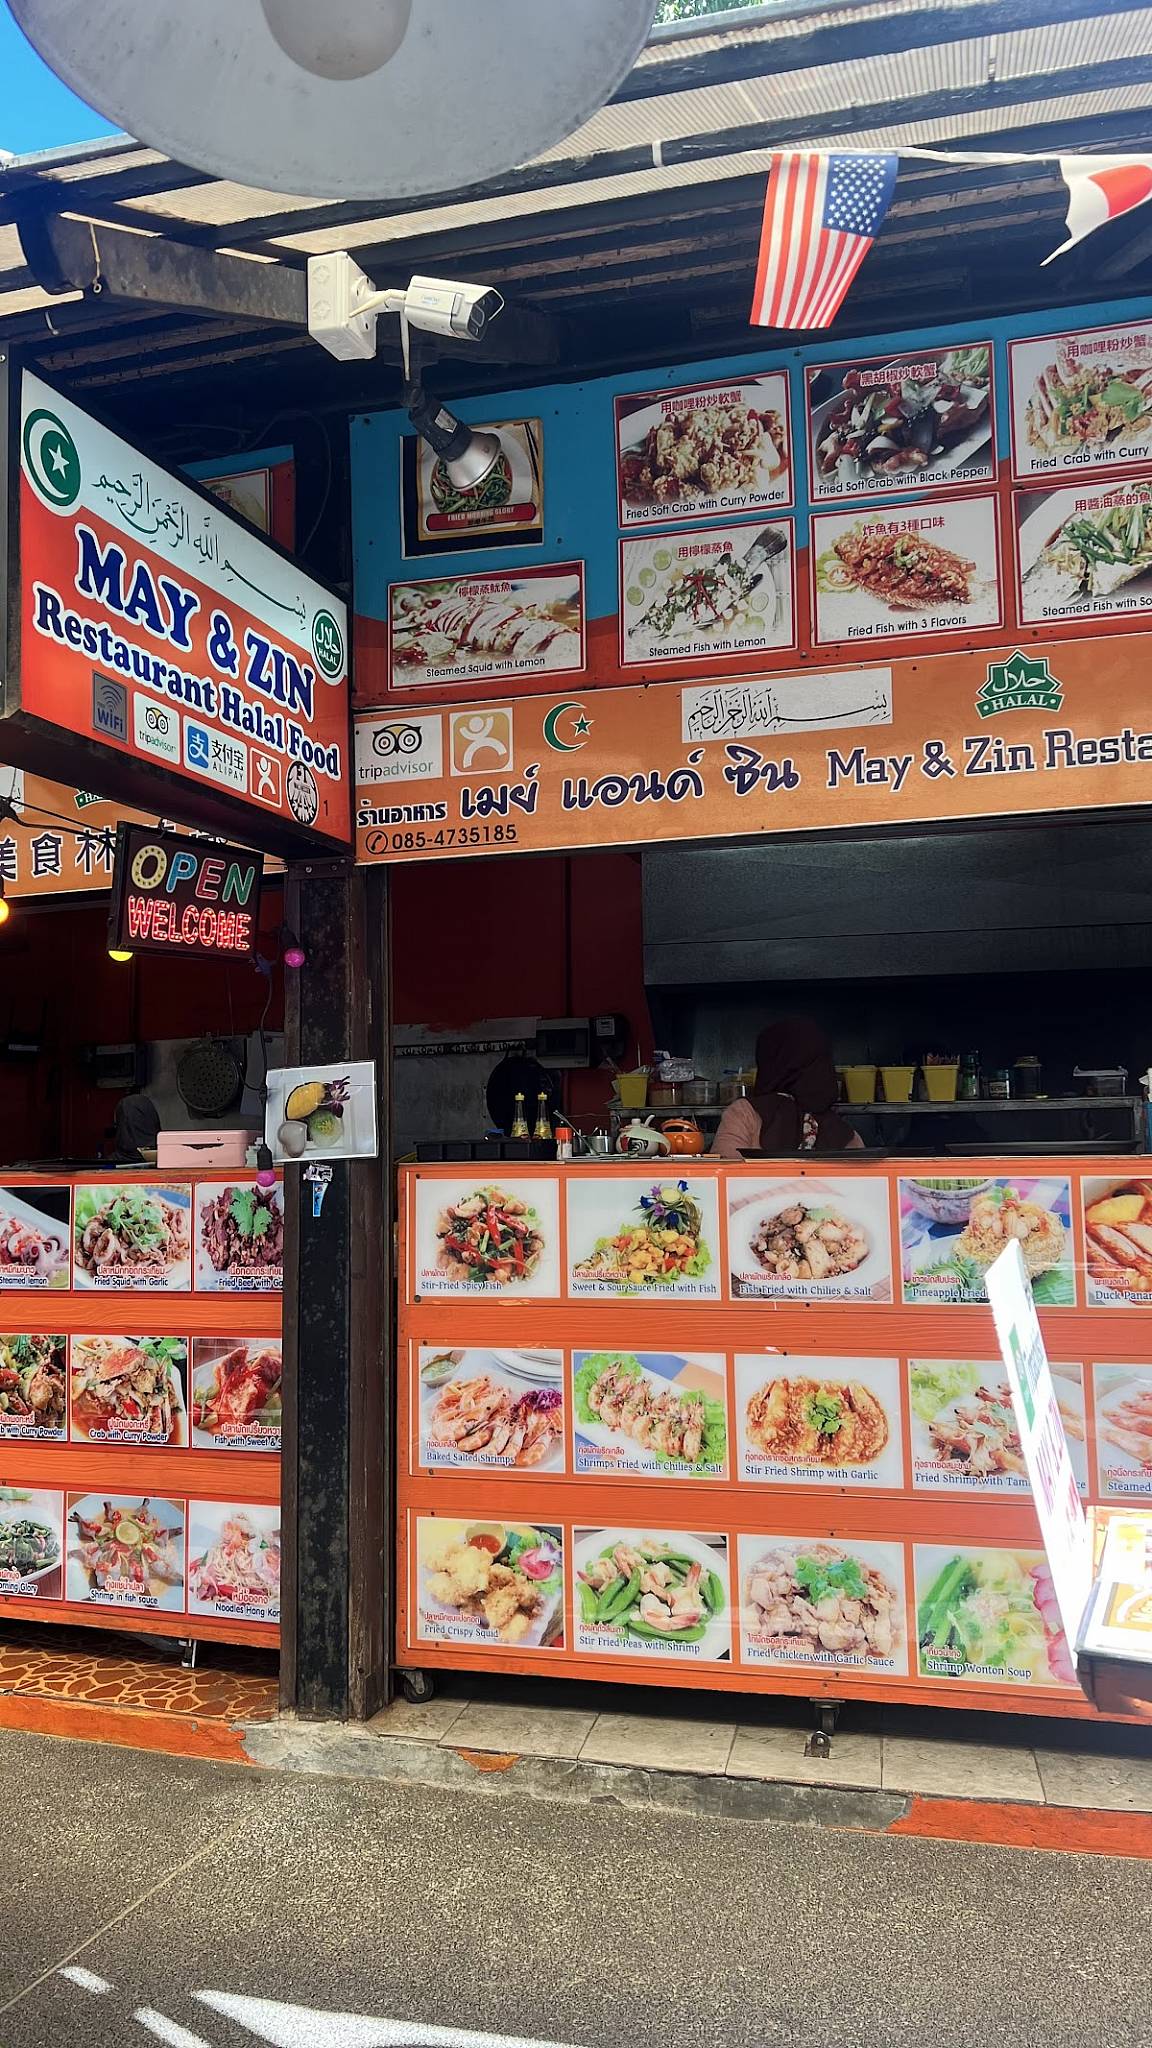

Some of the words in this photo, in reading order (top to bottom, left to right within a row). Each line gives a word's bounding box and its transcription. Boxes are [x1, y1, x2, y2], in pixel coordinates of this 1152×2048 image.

[860, 363, 937, 387] 黑胡椒炒軟蟹
[661, 390, 742, 414] 用咖哩粉炒軟蟹
[1030, 457, 1057, 469] Fried
[1063, 453, 1091, 465] Crab
[1093, 449, 1115, 461] with
[1119, 446, 1149, 458] Curry
[818, 484, 843, 495] Fried
[846, 481, 865, 491] Soft
[868, 477, 894, 489] Crab
[895, 473, 917, 485] with
[920, 469, 948, 483] Black
[950, 466, 988, 481] Pepper
[626, 509, 649, 519] Fried
[651, 505, 670, 516] Soft
[671, 502, 696, 514] Crab
[698, 499, 718, 511] with
[720, 495, 747, 508] Curry
[749, 490, 785, 503] Powder
[862, 516, 946, 537] 炸魚有3種口味
[1042, 602, 1090, 616] Steamed
[1093, 600, 1112, 611] Fish
[1115, 597, 1137, 608] with
[77, 527, 199, 648] MAY
[209, 613, 239, 674] &
[248, 632, 314, 718] ZIN
[848, 625, 873, 637] Fried
[875, 622, 894, 633] Fish
[897, 619, 918, 631] with
[921, 618, 928, 629] 3
[931, 615, 967, 628] Flavors
[649, 646, 691, 657] Steamed
[693, 642, 711, 652] Fish
[712, 639, 732, 650] with
[734, 636, 766, 648] Lemon
[318, 648, 338, 666] HALAL
[426, 665, 466, 677] Steamed
[467, 662, 493, 675] Squid
[494, 659, 513, 670] with
[515, 657, 546, 668] Lemon
[36, 588, 216, 714] Restaurant
[221, 686, 284, 749] Halal
[289, 722, 340, 777] Food
[991, 693, 1049, 710] HALAL
[139, 730, 174, 752] tripadvisor
[211, 739, 244, 771] 支付宝
[826, 746, 913, 792] May
[922, 740, 957, 780] &
[963, 737, 1035, 777] Zin
[1044, 730, 1152, 768] Resta
[212, 761, 243, 781] ALIPAY
[358, 760, 434, 781] tripadvisor
[459, 763, 541, 818] เมย์
[562, 747, 706, 809] แอนด์
[724, 743, 800, 796] ซิน
[357, 799, 448, 826] ร้านอาหาร
[392, 824, 518, 850] 085-4735185
[131, 845, 256, 905] OPEN
[127, 894, 252, 951] WELCOME
[94, 1277, 110, 1286] Fried
[112, 1277, 131, 1287] Squid
[132, 1278, 147, 1286] with
[149, 1277, 169, 1287] Garlic
[218, 1278, 236, 1287] Fried
[238, 1278, 254, 1287] Beef
[256, 1279, 271, 1287] with
[421, 1280, 459, 1290] Stir-Fried
[461, 1281, 484, 1291] Spicy
[485, 1282, 502, 1290] Fish
[572, 1282, 596, 1291] Sweet
[599, 1283, 605, 1291] &
[607, 1283, 626, 1292] Sour
[628, 1284, 652, 1292] Sauce
[654, 1283, 675, 1292] Fried
[678, 1284, 697, 1292] with
[699, 1284, 717, 1294] Fish
[740, 1284, 759, 1294] Fish
[762, 1285, 785, 1295] Fried
[787, 1285, 808, 1295] with
[810, 1286, 842, 1295] Chilies
[844, 1287, 850, 1295] &
[854, 1286, 872, 1296] Salt
[912, 1287, 961, 1299] Pineapple
[962, 1288, 987, 1298] Fried
[1095, 1290, 1121, 1300] Duck
[7, 1426, 20, 1434] with
[21, 1426, 38, 1437] Curry
[39, 1427, 63, 1436] Powder
[89, 1429, 106, 1438] Crab
[107, 1430, 121, 1439] with
[123, 1431, 141, 1441] Curry
[142, 1432, 168, 1441] Powder
[214, 1435, 228, 1444] Fish
[230, 1436, 245, 1445] with
[247, 1437, 268, 1446] Sweet
[270, 1439, 276, 1447] &
[426, 1452, 451, 1461] Baked
[453, 1453, 478, 1462] Salted
[480, 1455, 515, 1466] Shrimps
[579, 1458, 614, 1469] Shrimps
[617, 1459, 639, 1469] Fried
[641, 1460, 661, 1470] with
[663, 1461, 693, 1471] Chilies
[695, 1463, 703, 1472] &
[705, 1463, 723, 1473] Salt
[745, 1465, 762, 1475] Stir
[764, 1466, 788, 1476] Fried
[790, 1467, 825, 1479] Shrimp
[827, 1468, 848, 1479] with
[851, 1470, 879, 1480] Garlic
[915, 1472, 941, 1483] Fried
[942, 1474, 979, 1487] Shrimp
[981, 1475, 1003, 1486] with
[1108, 1481, 1152, 1492] Steamed
[20, 1582, 38, 1594] Glory
[90, 1589, 114, 1601] Shrimp
[116, 1592, 123, 1601] in
[125, 1593, 137, 1602] fish
[138, 1596, 159, 1604] sauce
[215, 1602, 244, 1613] Noodles
[246, 1606, 265, 1617] Hong
[424, 1624, 446, 1634] Fried
[447, 1626, 474, 1638] Crispy
[475, 1628, 499, 1638] Squid
[579, 1635, 595, 1645] Stir
[598, 1637, 620, 1647] Fried
[622, 1639, 643, 1649] Peas
[645, 1641, 665, 1650] with
[667, 1643, 701, 1655] Shrimp
[747, 1647, 771, 1658] Fried
[773, 1649, 811, 1660] Chicken
[812, 1652, 835, 1662] with
[836, 1654, 864, 1665] Garlic
[867, 1656, 895, 1667] Sauce
[927, 1660, 963, 1675] Shrimp
[964, 1663, 1005, 1676] Wonton
[1007, 1667, 1032, 1679] Soup
